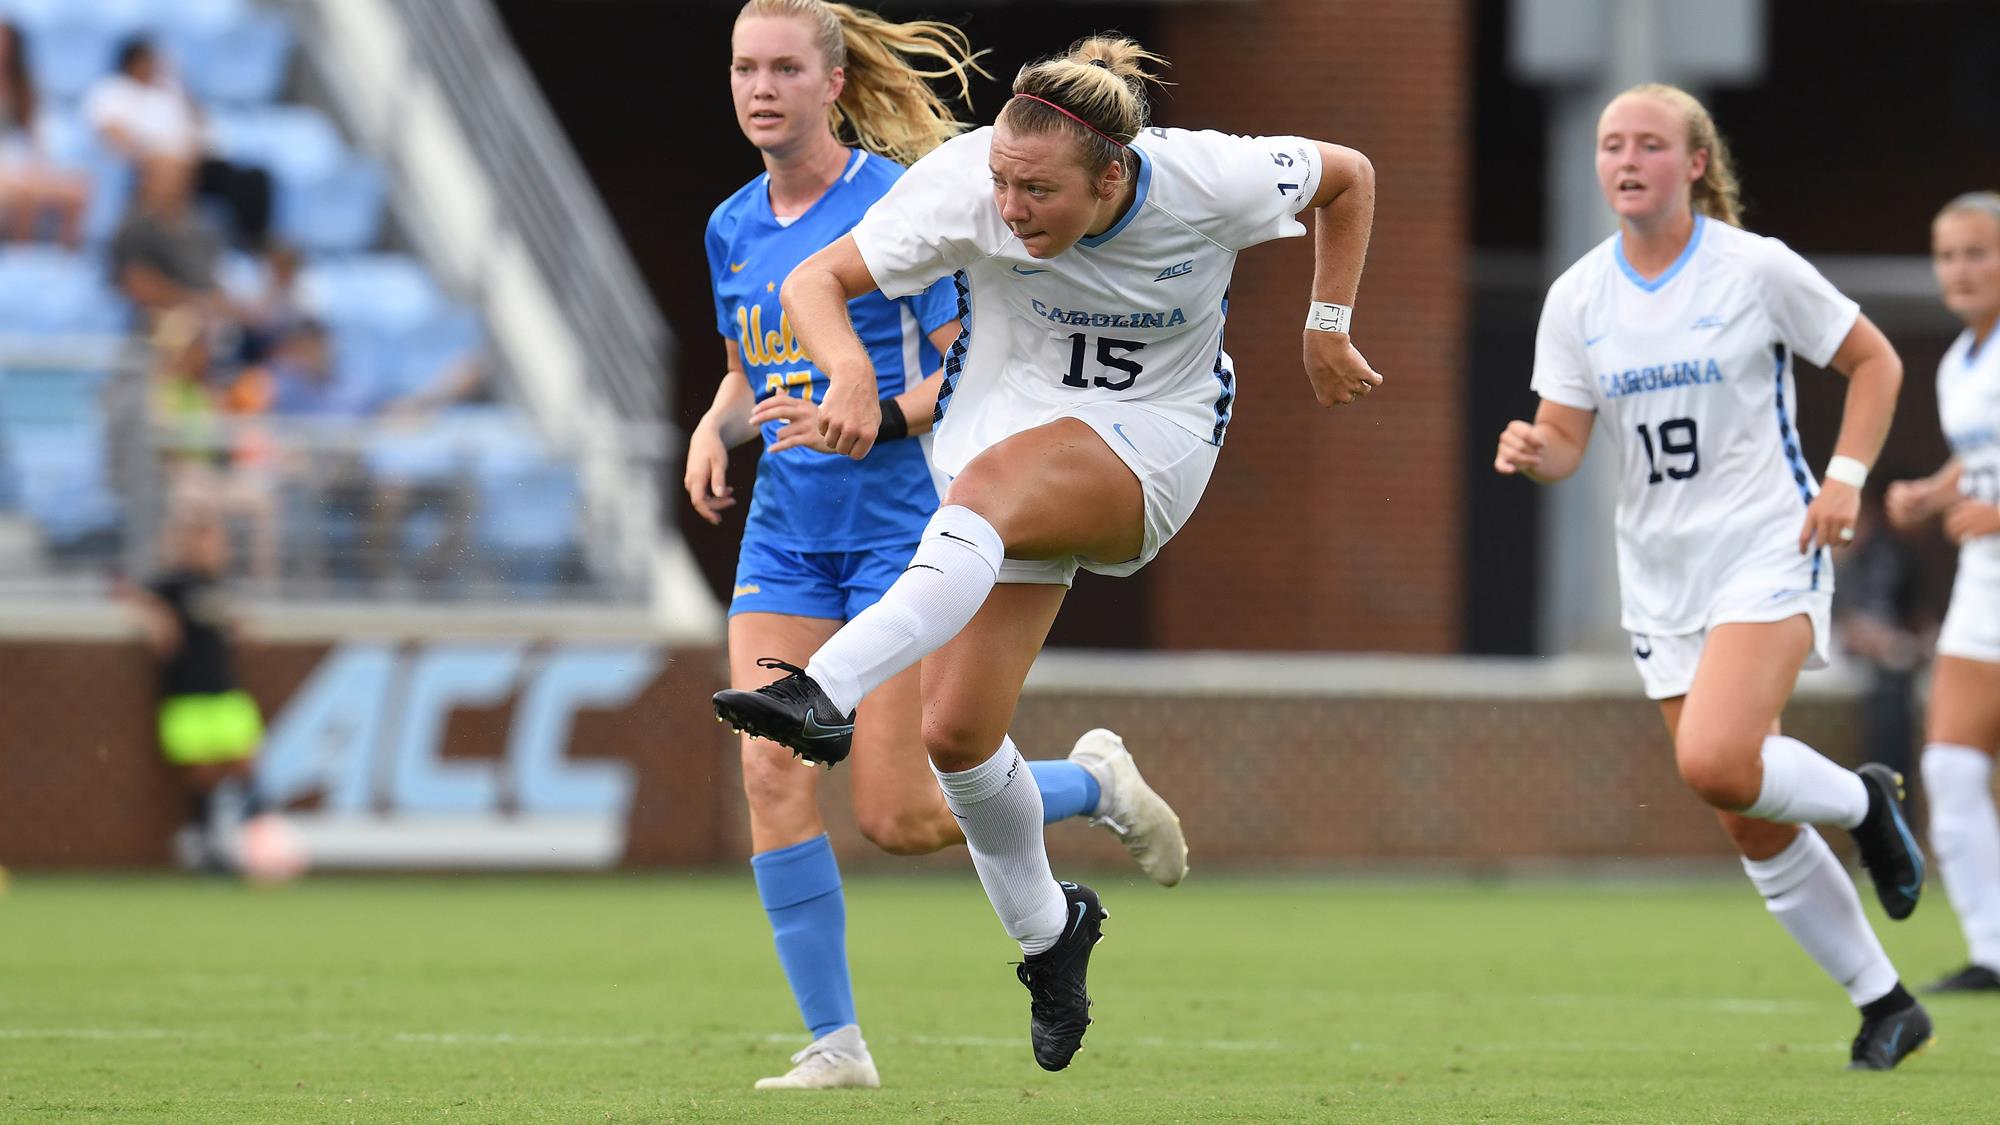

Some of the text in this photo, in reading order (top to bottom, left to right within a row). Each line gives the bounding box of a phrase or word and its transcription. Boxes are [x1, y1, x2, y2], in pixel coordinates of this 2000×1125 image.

[1156, 259, 1193, 278] ACC
[737, 304, 812, 367] Ucl
[1031, 298, 1187, 328] CAROLINA
[1319, 305, 1341, 331] FTS
[1062, 332, 1147, 392] 15
[1637, 416, 1700, 484] 19
[255, 641, 665, 812] ACC
